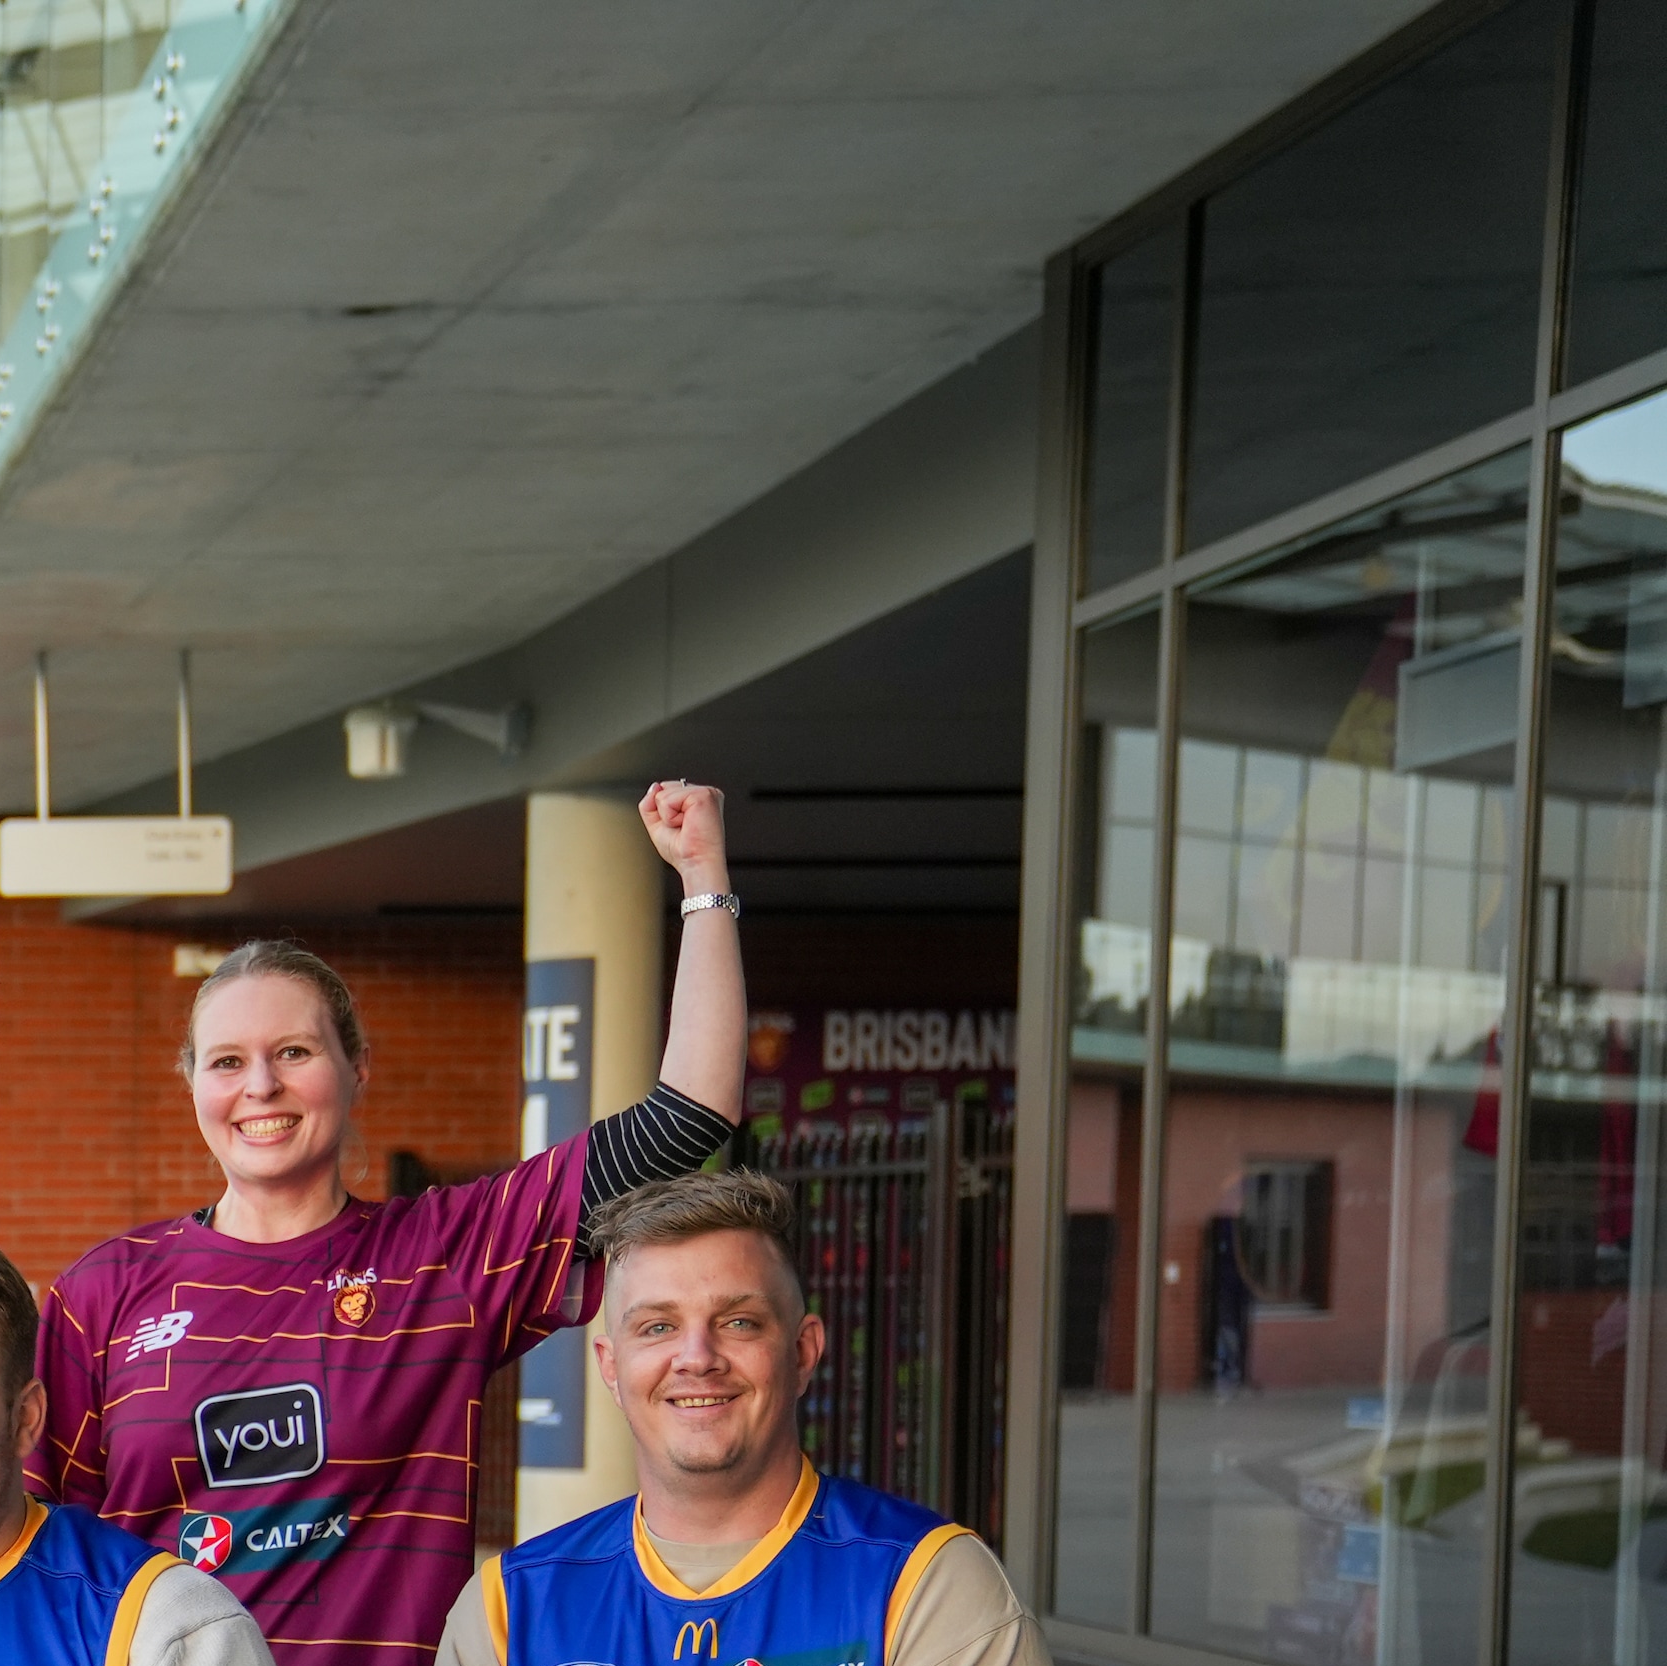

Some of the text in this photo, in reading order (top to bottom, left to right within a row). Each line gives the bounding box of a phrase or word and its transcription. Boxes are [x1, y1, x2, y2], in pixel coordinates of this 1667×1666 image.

[823, 1010, 1017, 1071] BRISBAN
[327, 1267, 377, 1292] LIONS
[214, 1400, 305, 1468] youi
[246, 1514, 346, 1552] CALTEX
